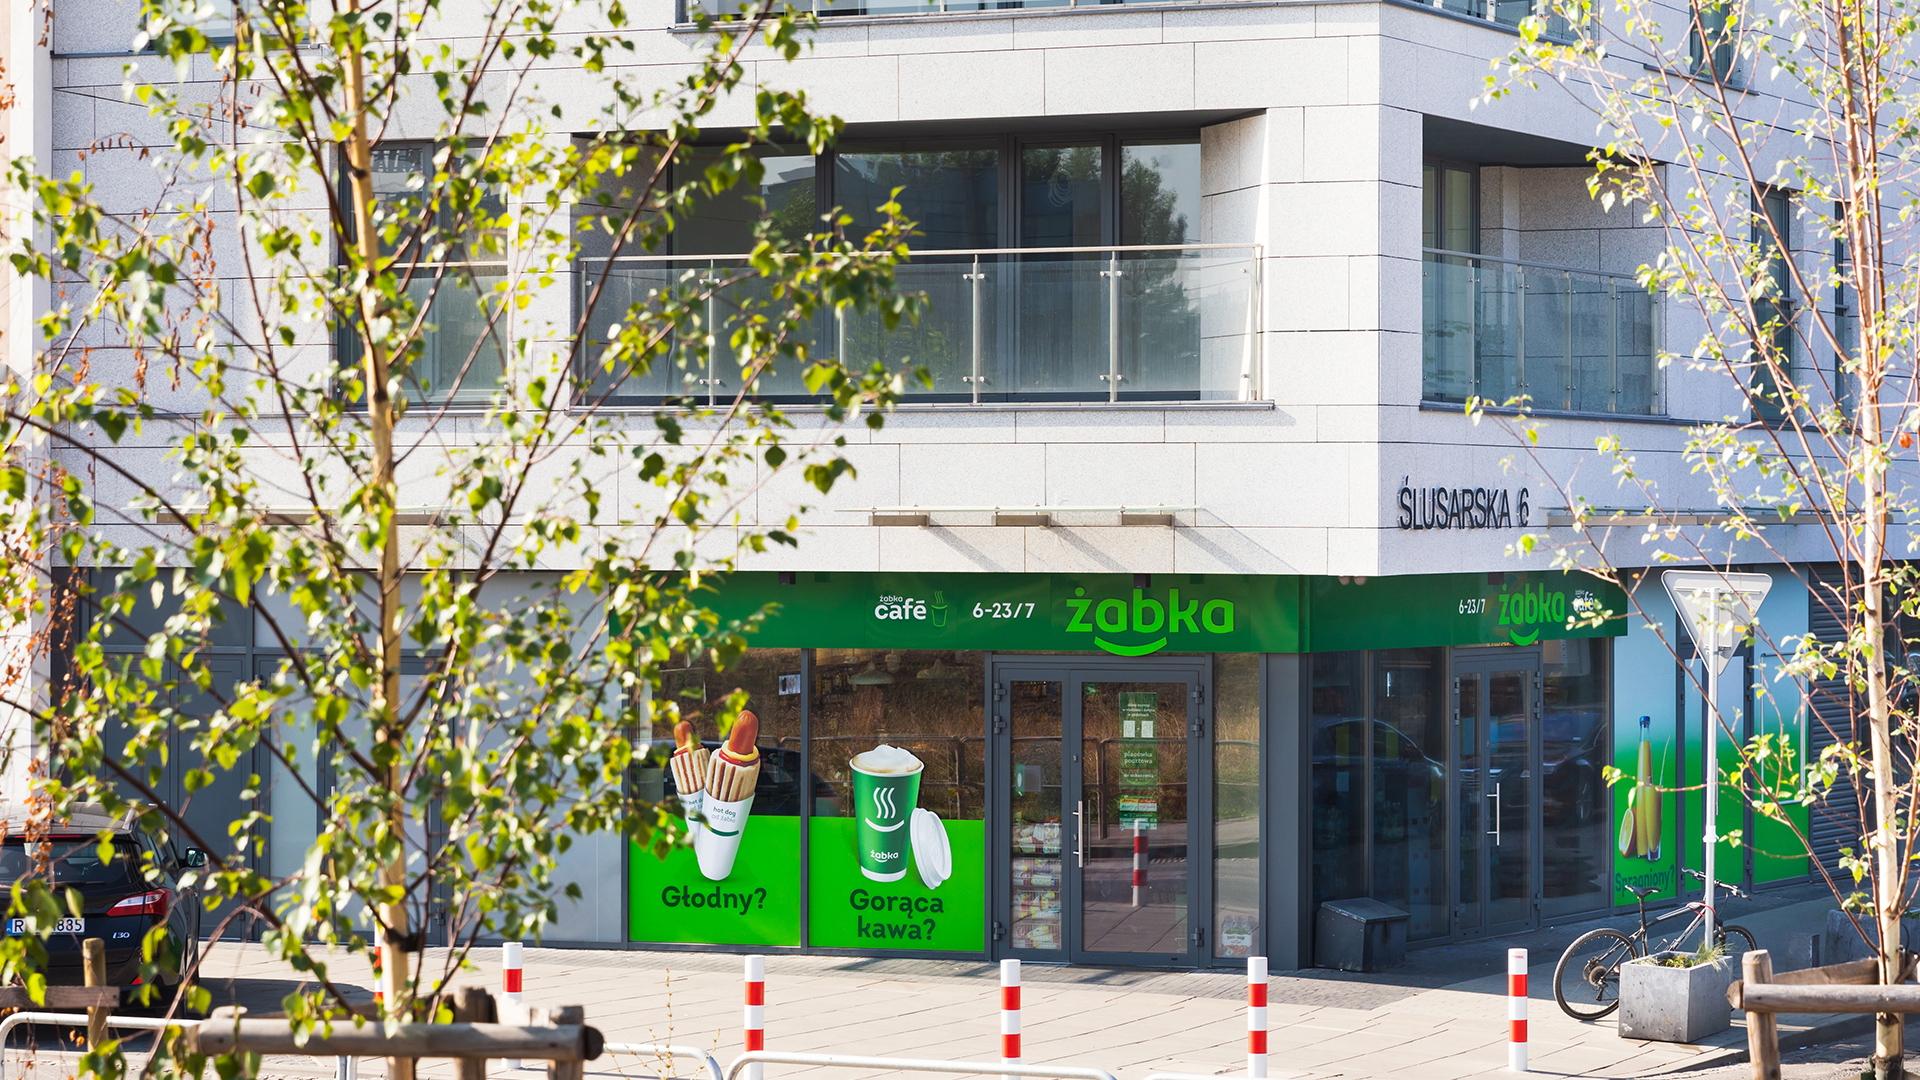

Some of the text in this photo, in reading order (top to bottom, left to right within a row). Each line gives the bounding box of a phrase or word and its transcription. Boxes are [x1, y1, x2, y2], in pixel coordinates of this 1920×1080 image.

[1399, 475, 1529, 529] ŚLUSARSKA 6
[879, 594, 903, 603] żabka
[972, 602, 1035, 618] 6-23/7
[1065, 586, 1234, 634] żabka
[1458, 598, 1486, 614] 6-23/7
[1498, 582, 1565, 625] żabka
[712, 806, 724, 814] hot
[725, 809, 736, 818] dog
[870, 849, 899, 860] żabka
[661, 885, 767, 915] Głodny?
[849, 889, 944, 919] Gorąca
[857, 916, 936, 940] kawa?
